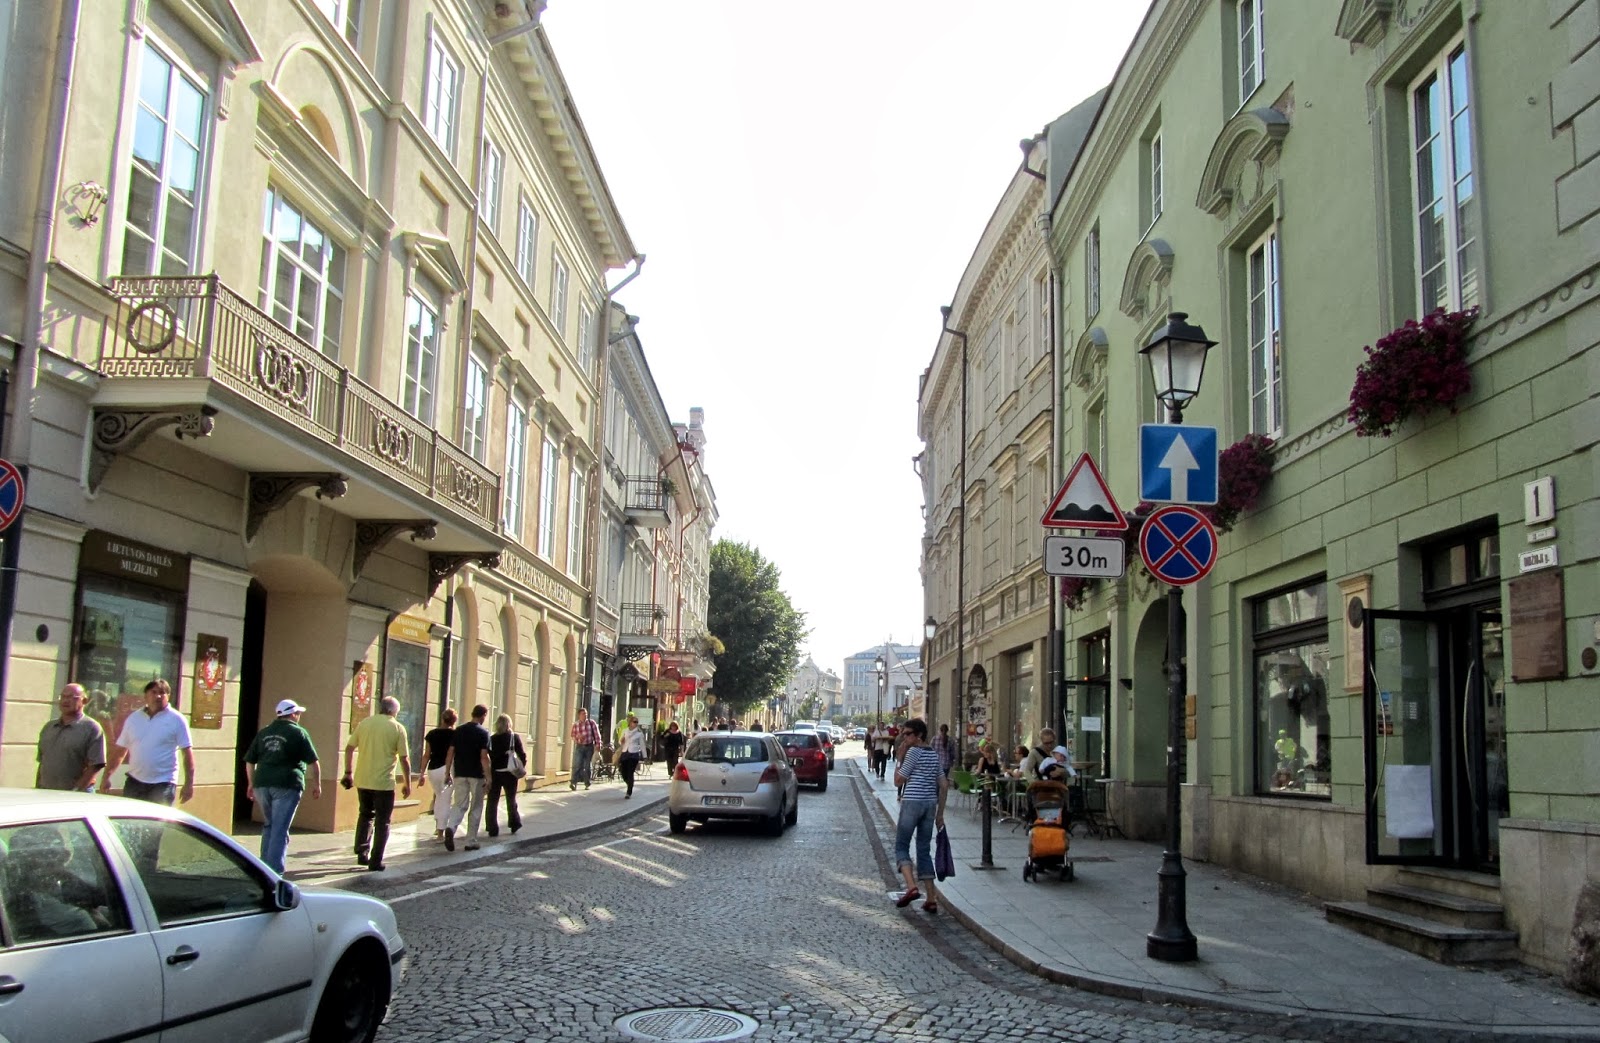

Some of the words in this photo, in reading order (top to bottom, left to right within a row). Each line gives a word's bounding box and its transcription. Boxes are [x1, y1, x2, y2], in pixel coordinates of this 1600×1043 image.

[1533, 485, 1540, 517] 1
[107, 541, 146, 559] LIETUVOS
[121, 559, 158, 577] MUZIEJUS
